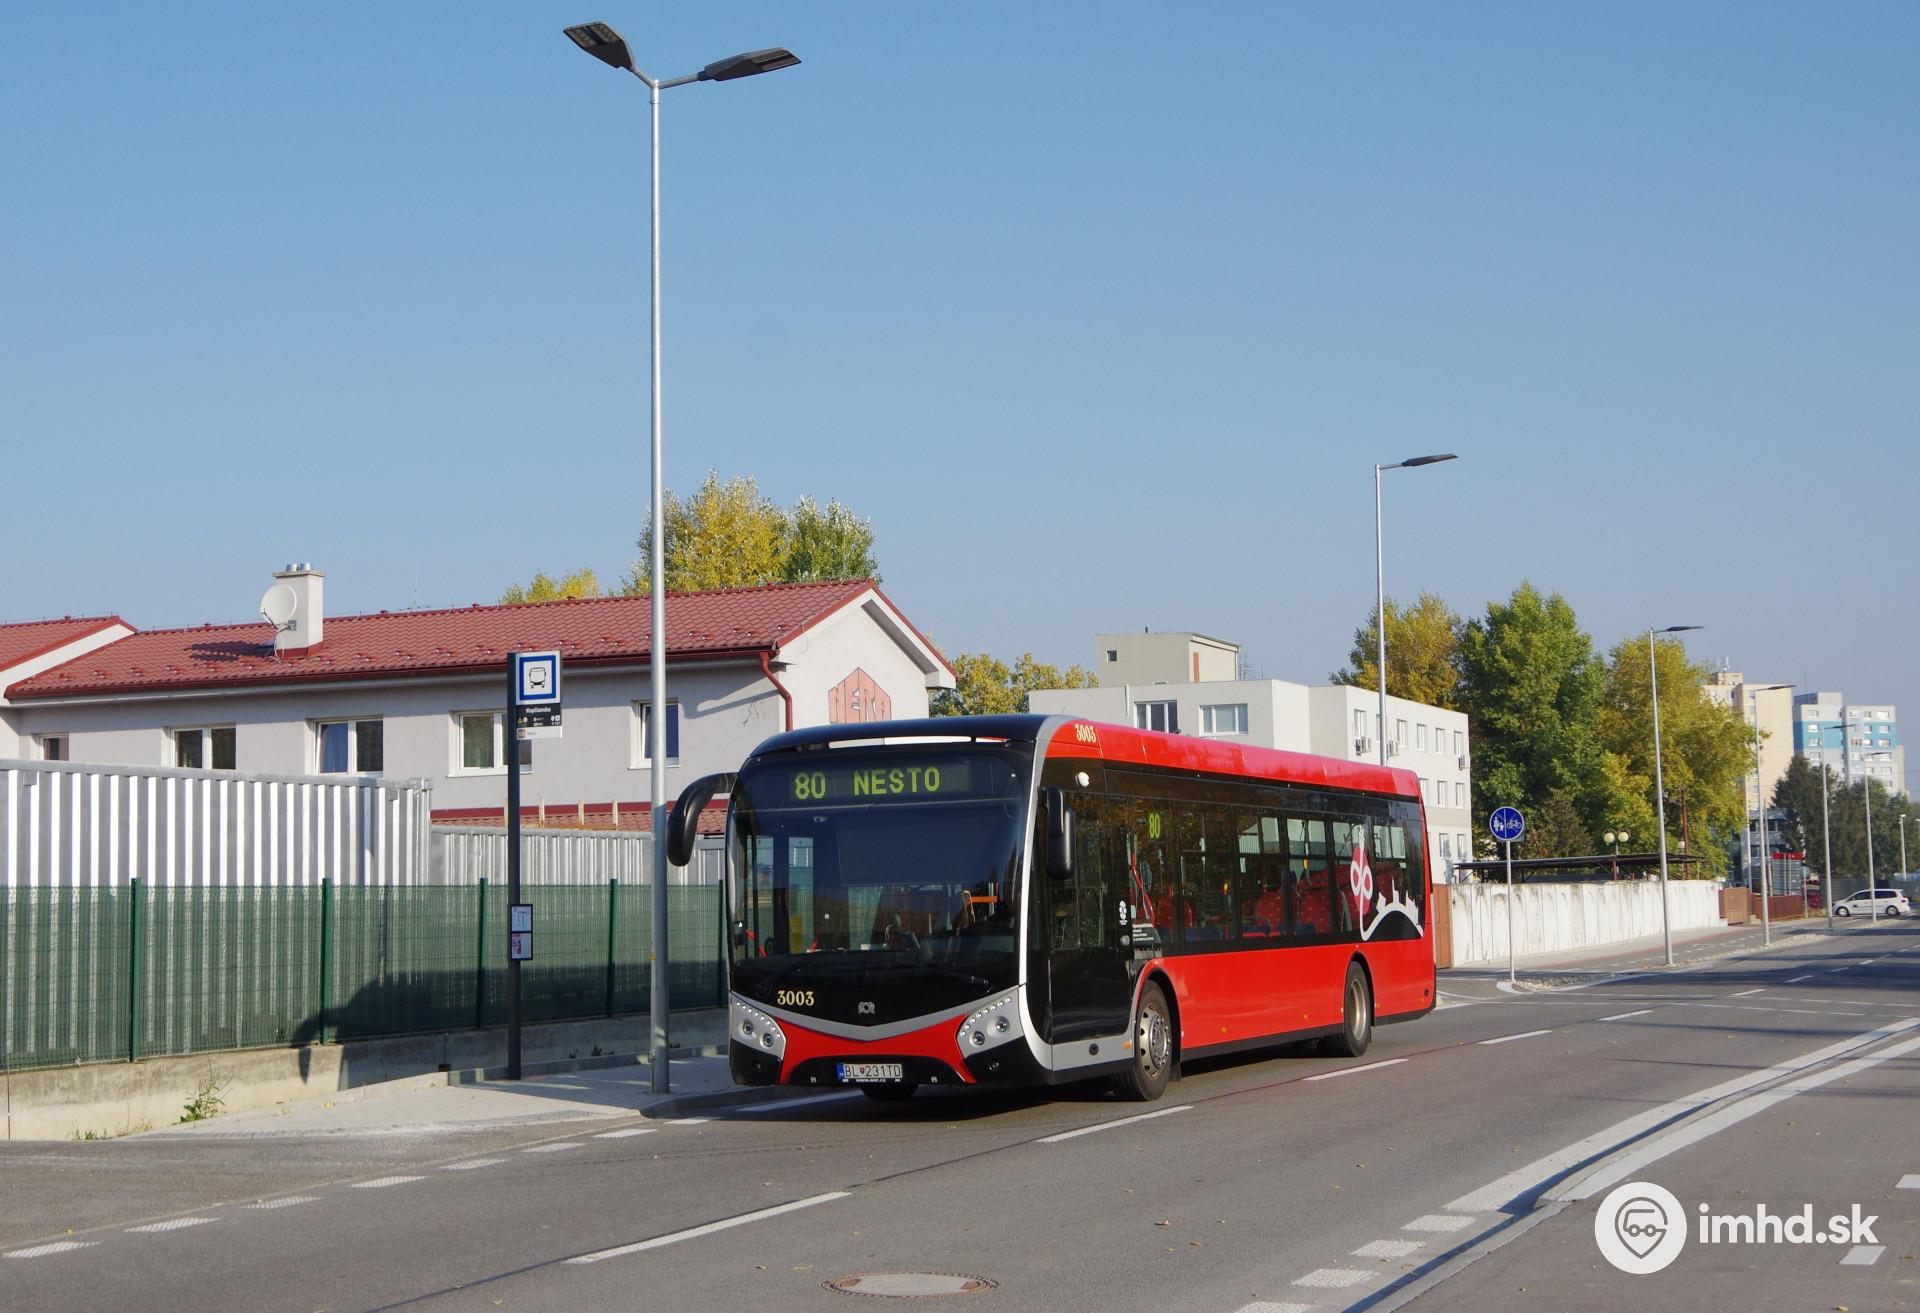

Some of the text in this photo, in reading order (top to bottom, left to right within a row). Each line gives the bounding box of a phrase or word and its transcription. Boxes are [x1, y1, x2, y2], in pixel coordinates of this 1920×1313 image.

[1074, 723, 1097, 743] 3003
[794, 766, 940, 800] 80 NESTO
[1148, 812, 1161, 839] 80
[777, 990, 815, 1006] 3003
[844, 1064, 901, 1077] BL 231TD
